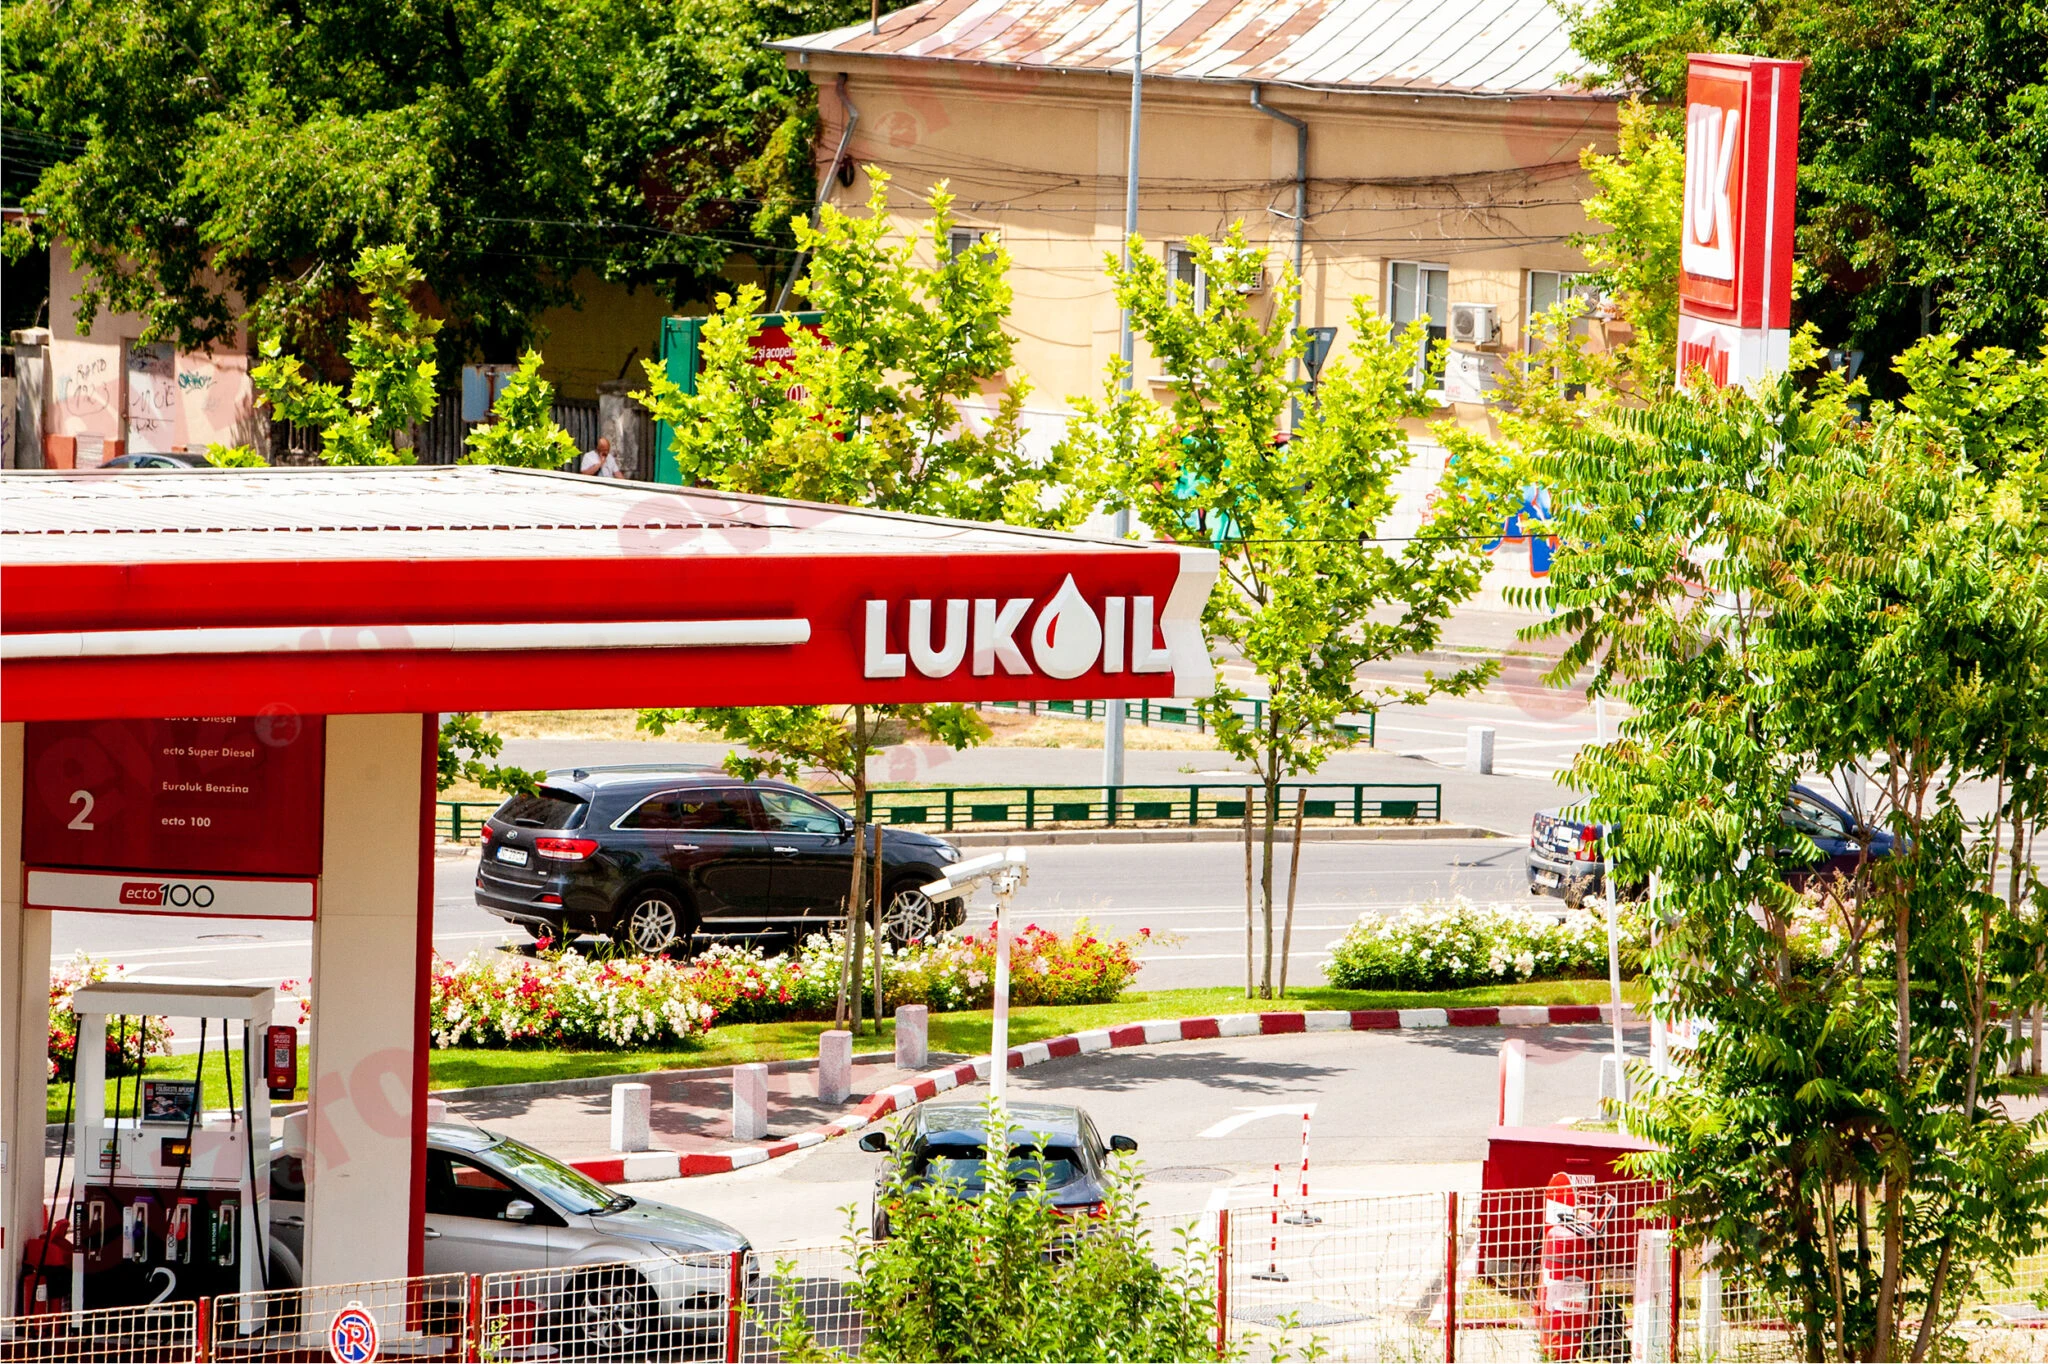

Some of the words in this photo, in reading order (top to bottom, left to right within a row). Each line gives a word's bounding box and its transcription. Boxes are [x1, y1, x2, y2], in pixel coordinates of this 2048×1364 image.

[864, 573, 1173, 679] LUKOIL
[163, 747, 185, 756] ecto
[188, 747, 219, 758] Super
[222, 747, 255, 758] Diesel
[162, 782, 202, 792] Euroluk
[205, 784, 249, 794] Benzina
[67, 790, 95, 831] 2
[161, 817, 186, 826] ecto
[190, 817, 211, 827] 100
[146, 1267, 177, 1314] 2
